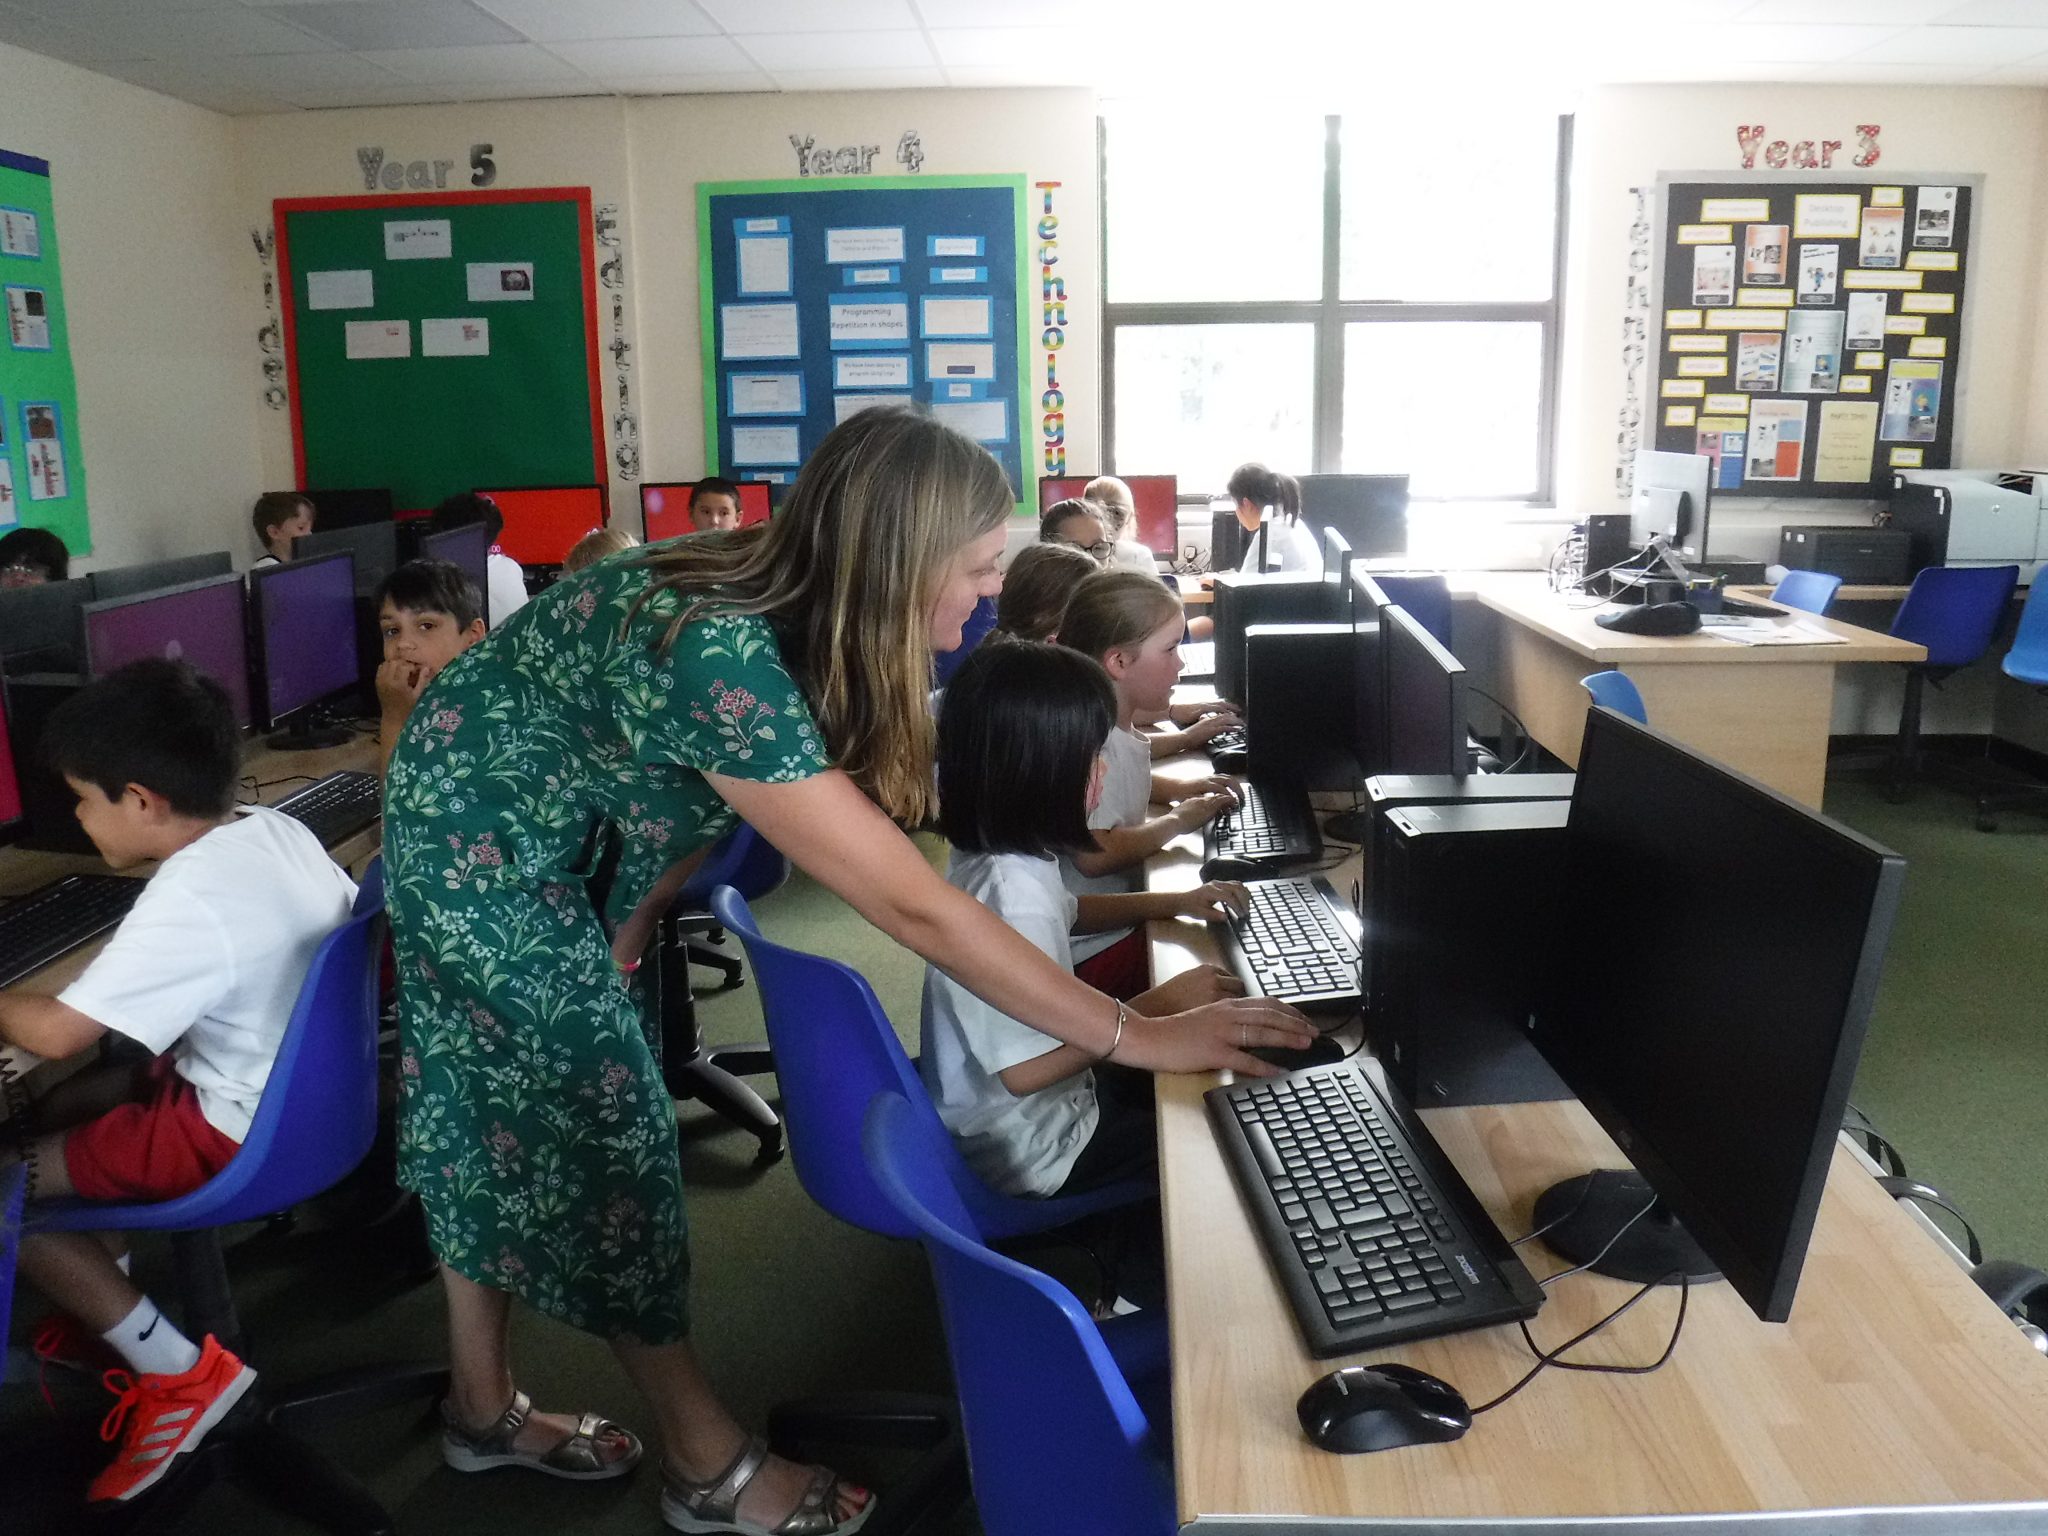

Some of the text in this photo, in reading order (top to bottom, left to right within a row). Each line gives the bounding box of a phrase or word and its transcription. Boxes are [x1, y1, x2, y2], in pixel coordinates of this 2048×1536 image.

[357, 143, 497, 190] Year 5
[788, 129, 925, 177] Year 4
[1736, 124, 1882, 170] Year 3
[842, 308, 892, 316] Programming
[1034, 181, 1069, 478] Technology
[596, 203, 641, 481] Editing
